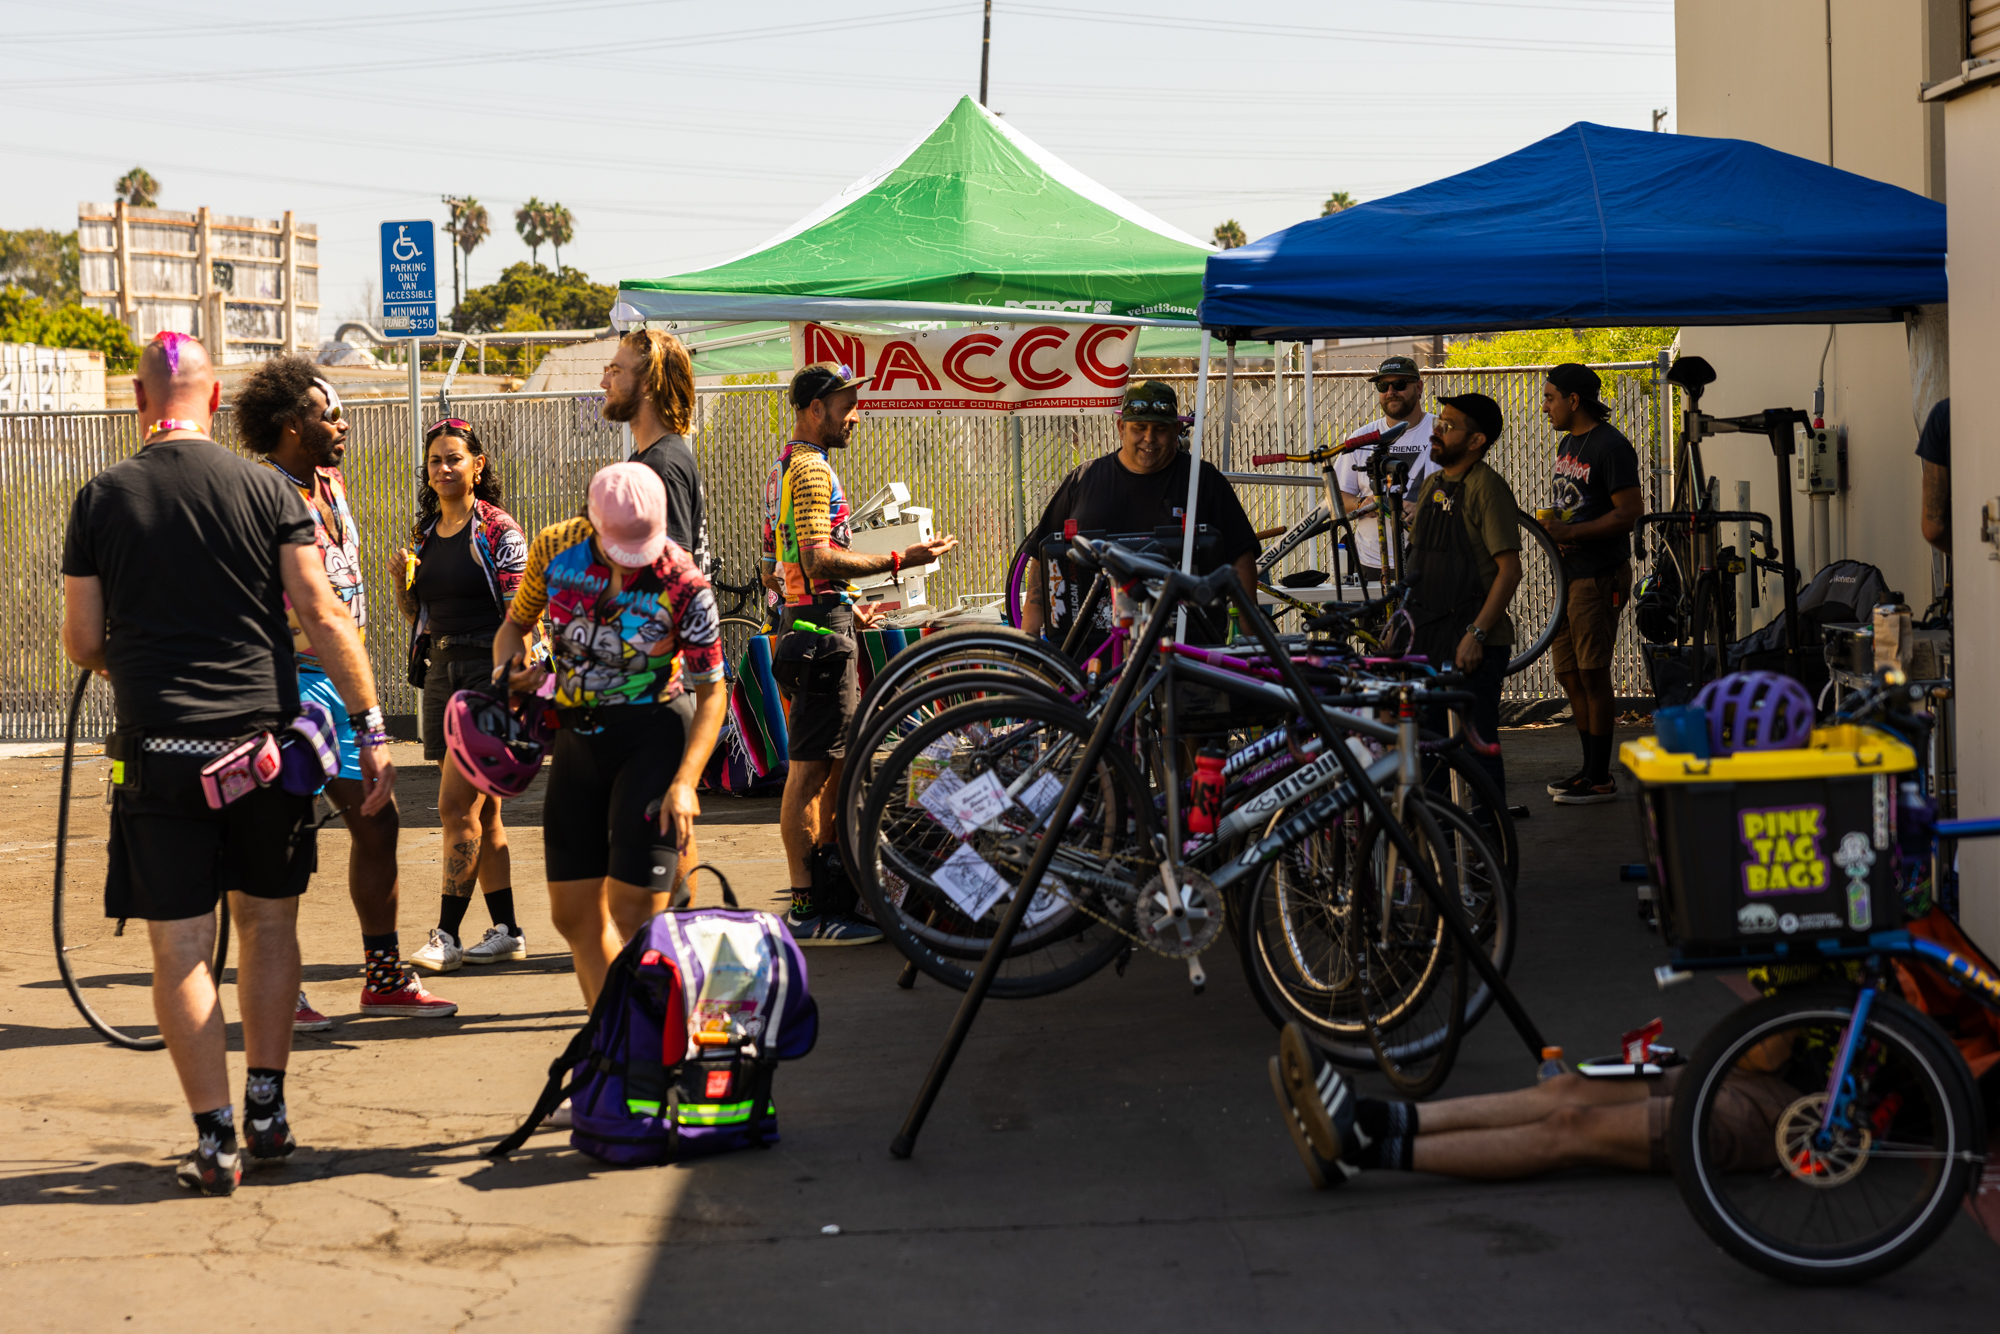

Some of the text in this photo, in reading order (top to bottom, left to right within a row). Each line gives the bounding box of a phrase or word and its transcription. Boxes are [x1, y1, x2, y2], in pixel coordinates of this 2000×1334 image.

[391, 263, 426, 272] PARKING
[398, 273, 418, 281] ONLY
[386, 290, 432, 299] ACCESSIBLE
[391, 306, 428, 316] MINIMUM
[409, 319, 434, 329] $250
[804, 322, 1137, 393] NACCC
[863, 400, 924, 409] AMERICAN
[928, 400, 966, 409] CYCLE
[969, 401, 1022, 410] COURIER
[1025, 397, 1124, 408] CHAMPIONSHIPS
[1389, 444, 1429, 453] FRIENDLY
[1742, 808, 1820, 840] PINK
[1752, 834, 1816, 865] TAG
[1745, 859, 1825, 892] BAGS
